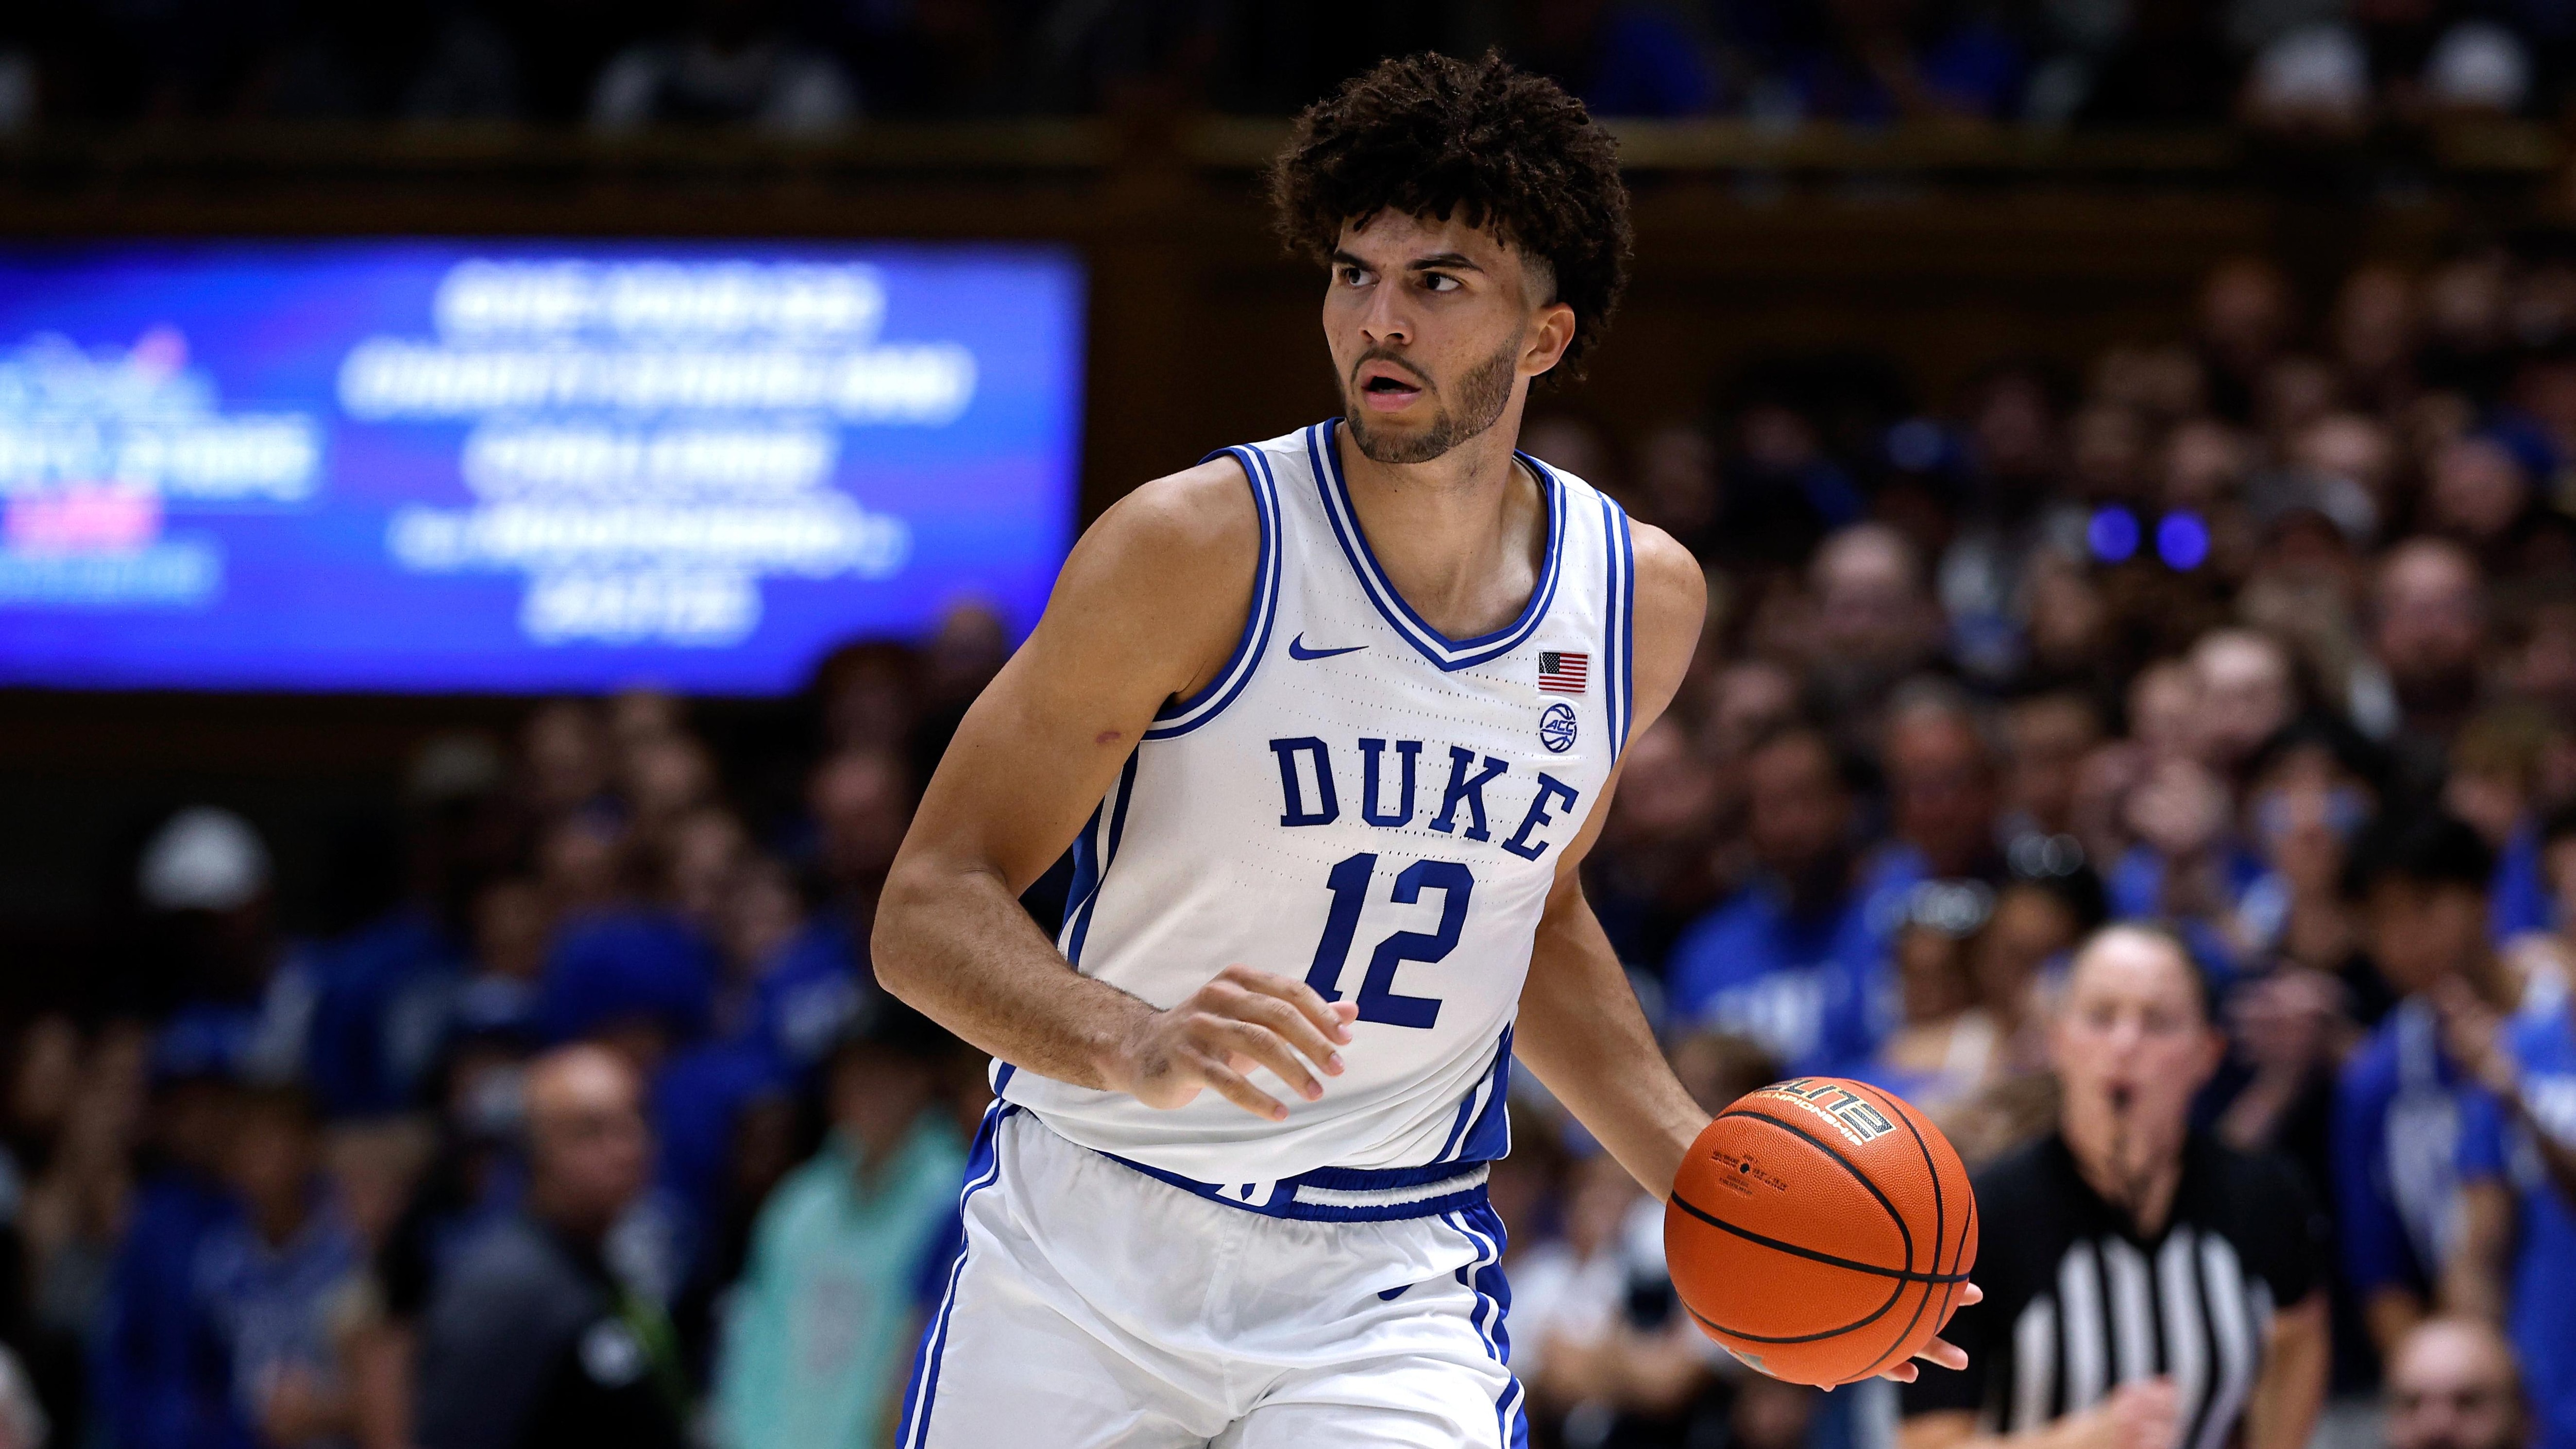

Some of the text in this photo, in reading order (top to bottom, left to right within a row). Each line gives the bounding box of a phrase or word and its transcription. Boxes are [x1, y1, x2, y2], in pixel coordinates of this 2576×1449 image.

[1545, 719, 1577, 733] ACC
[1269, 736, 1580, 862] DUKE
[1304, 852, 1475, 1029] 12
